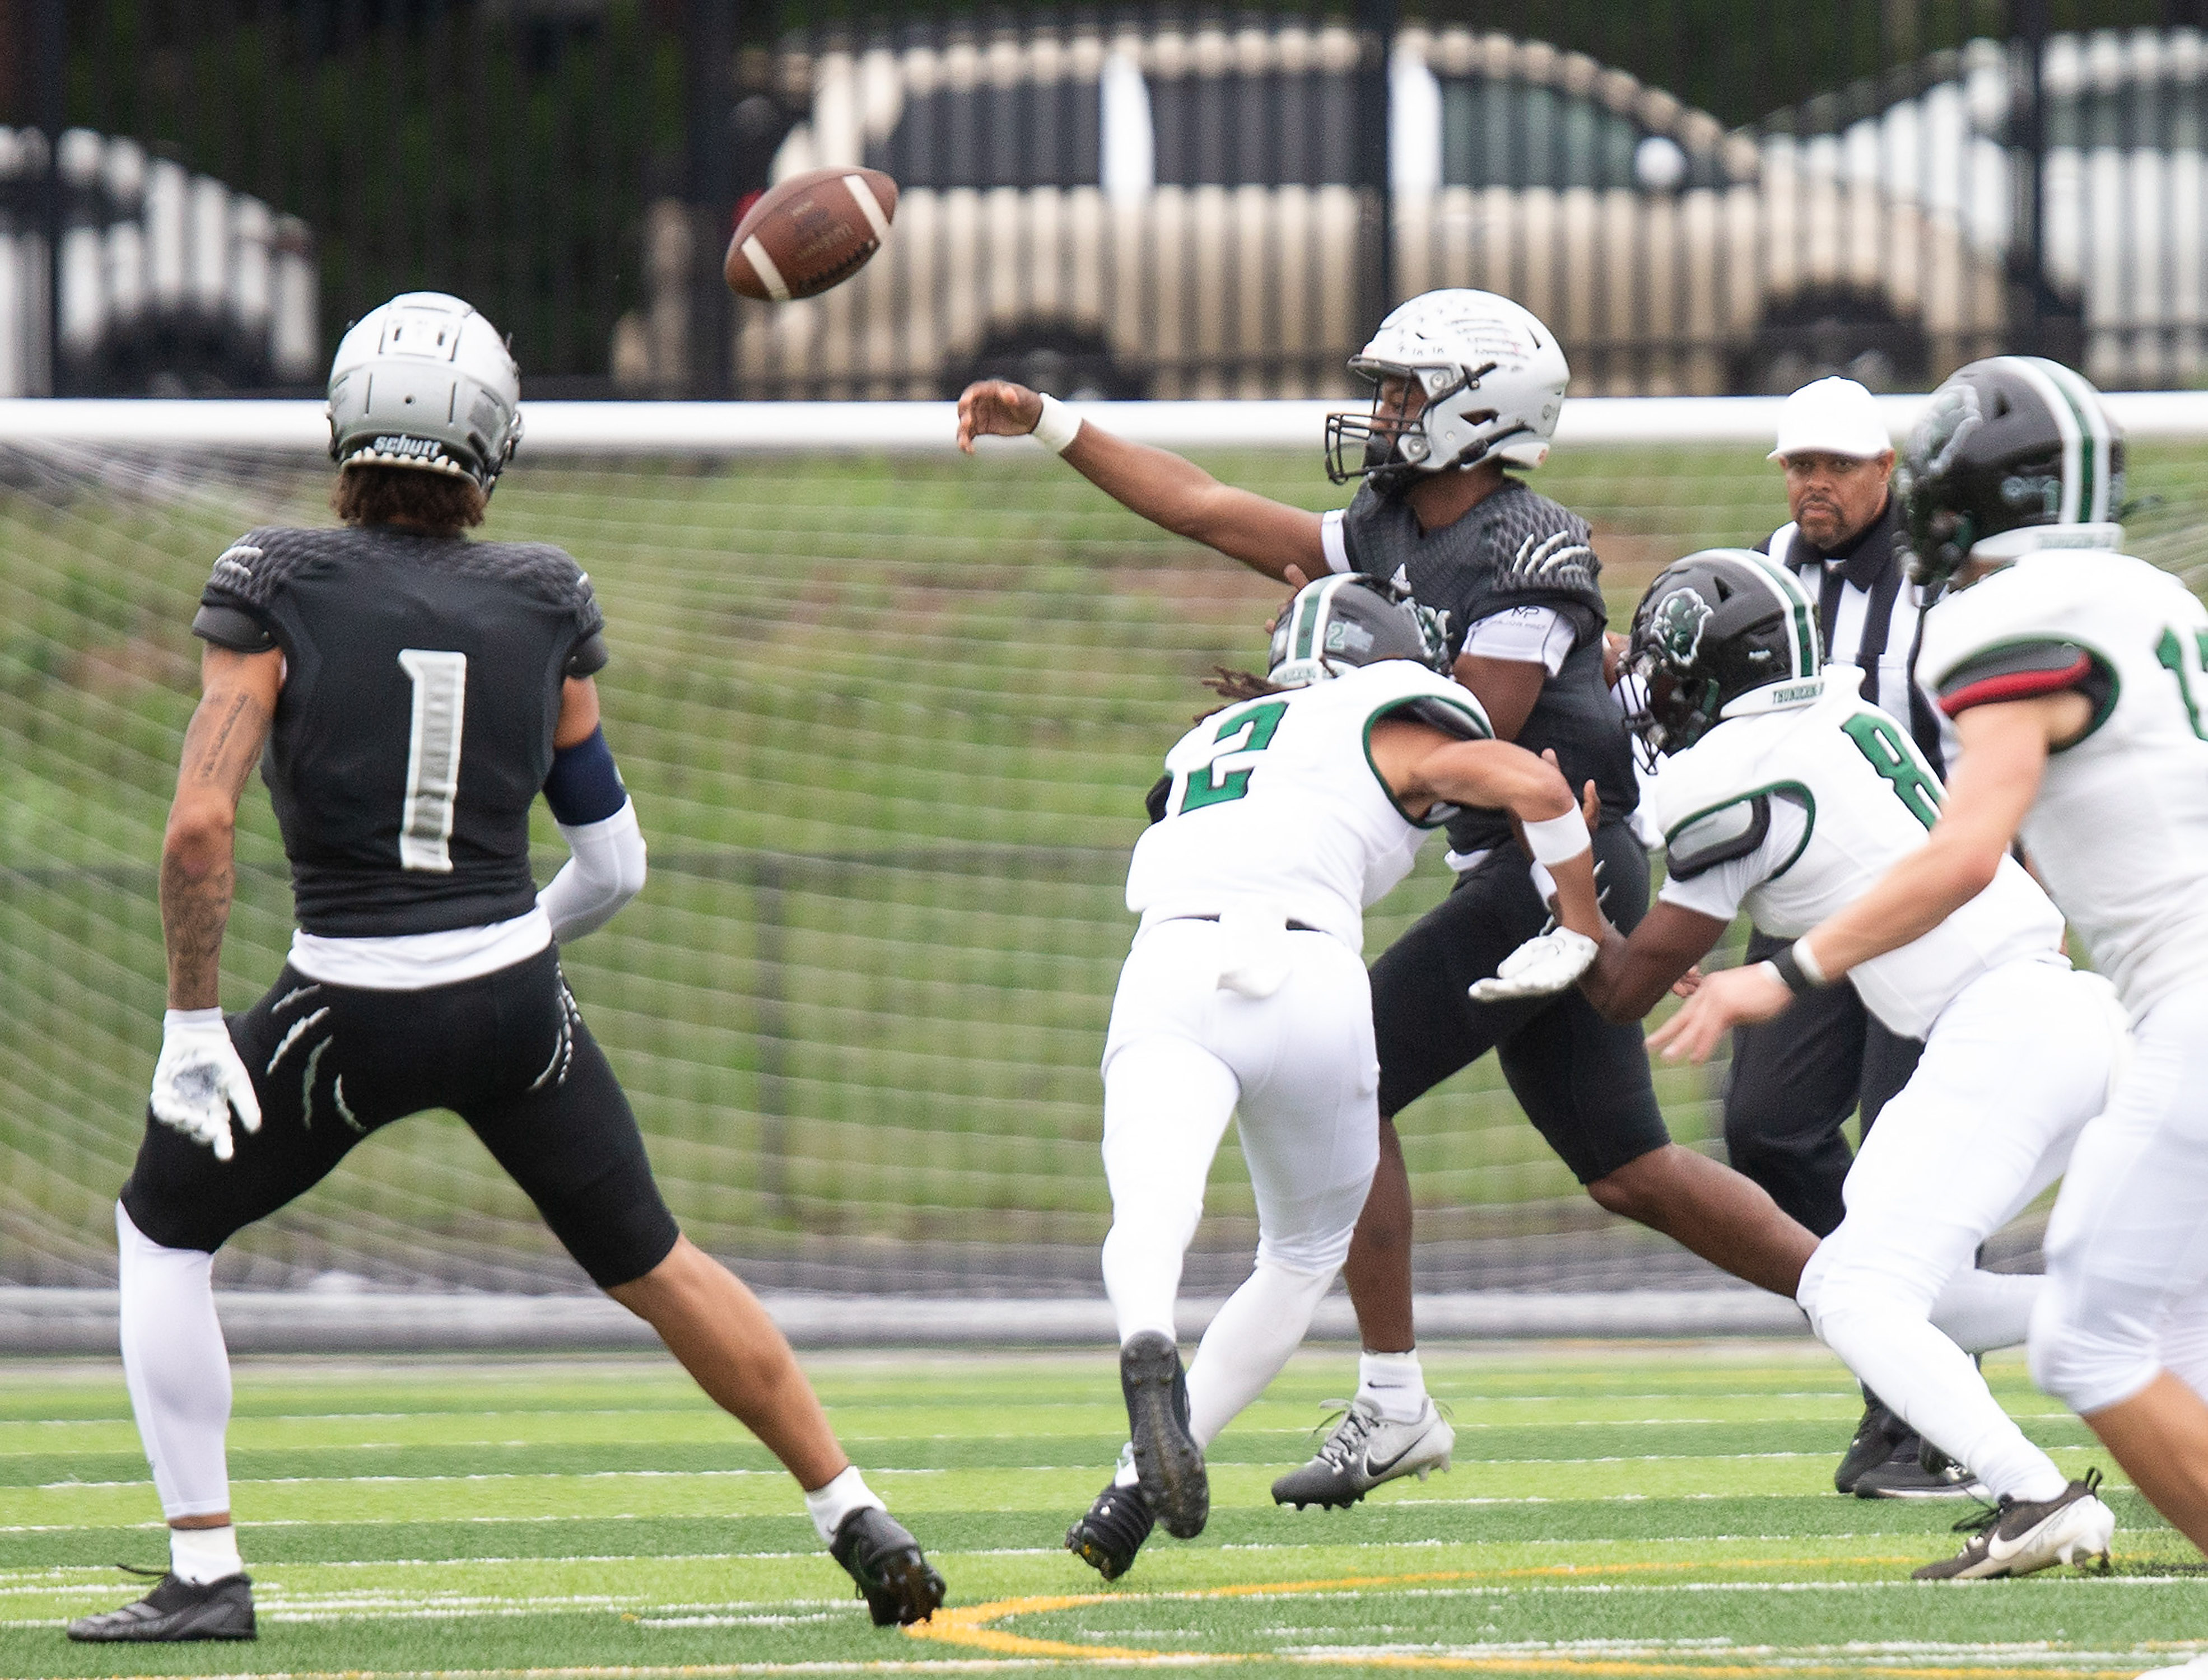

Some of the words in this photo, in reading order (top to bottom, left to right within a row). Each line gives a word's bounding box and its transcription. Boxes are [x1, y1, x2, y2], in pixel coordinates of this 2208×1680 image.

[374, 434, 441, 458] schutt
[1330, 624, 1344, 646] 2
[397, 648, 467, 872] 1
[1178, 701, 1289, 816] 2
[1839, 712, 1943, 832] 8
